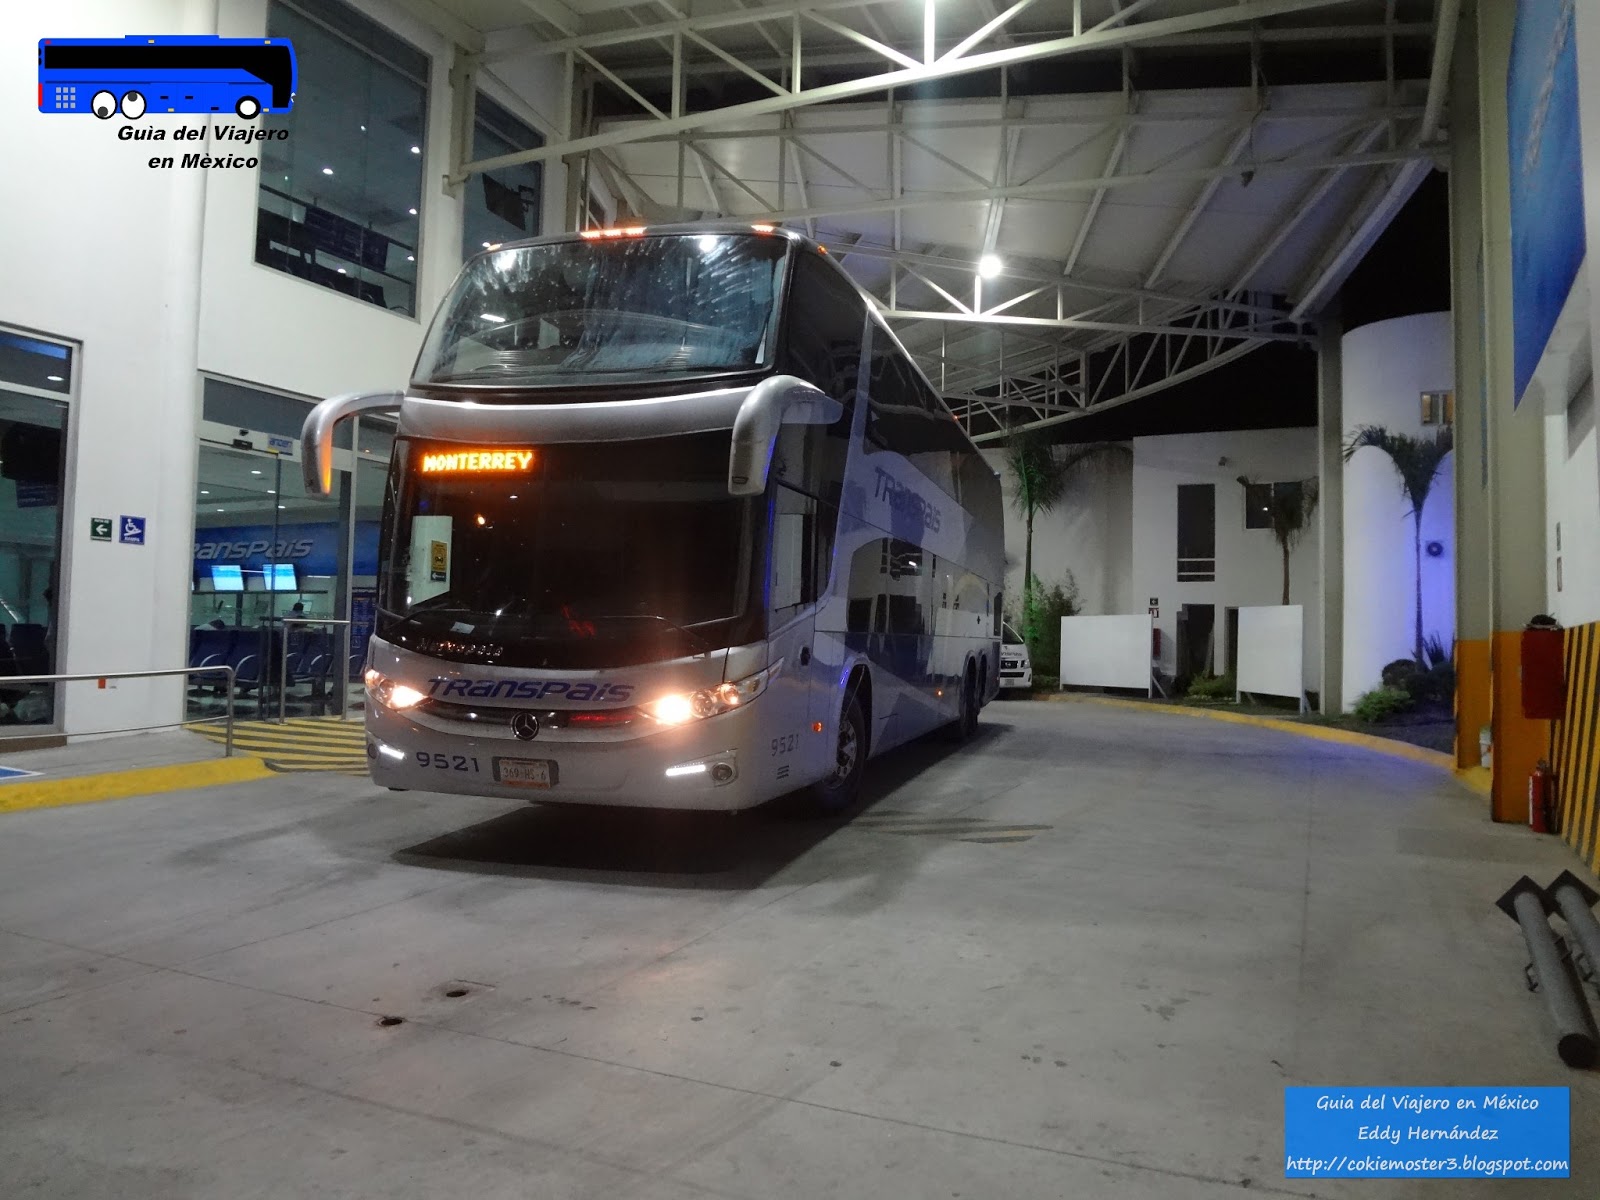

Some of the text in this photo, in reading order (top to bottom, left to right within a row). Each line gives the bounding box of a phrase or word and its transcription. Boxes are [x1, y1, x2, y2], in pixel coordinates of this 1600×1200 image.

[422, 451, 533, 472] MONTERREY
[771, 734, 799, 757] 9521
[416, 751, 480, 773] 9521
